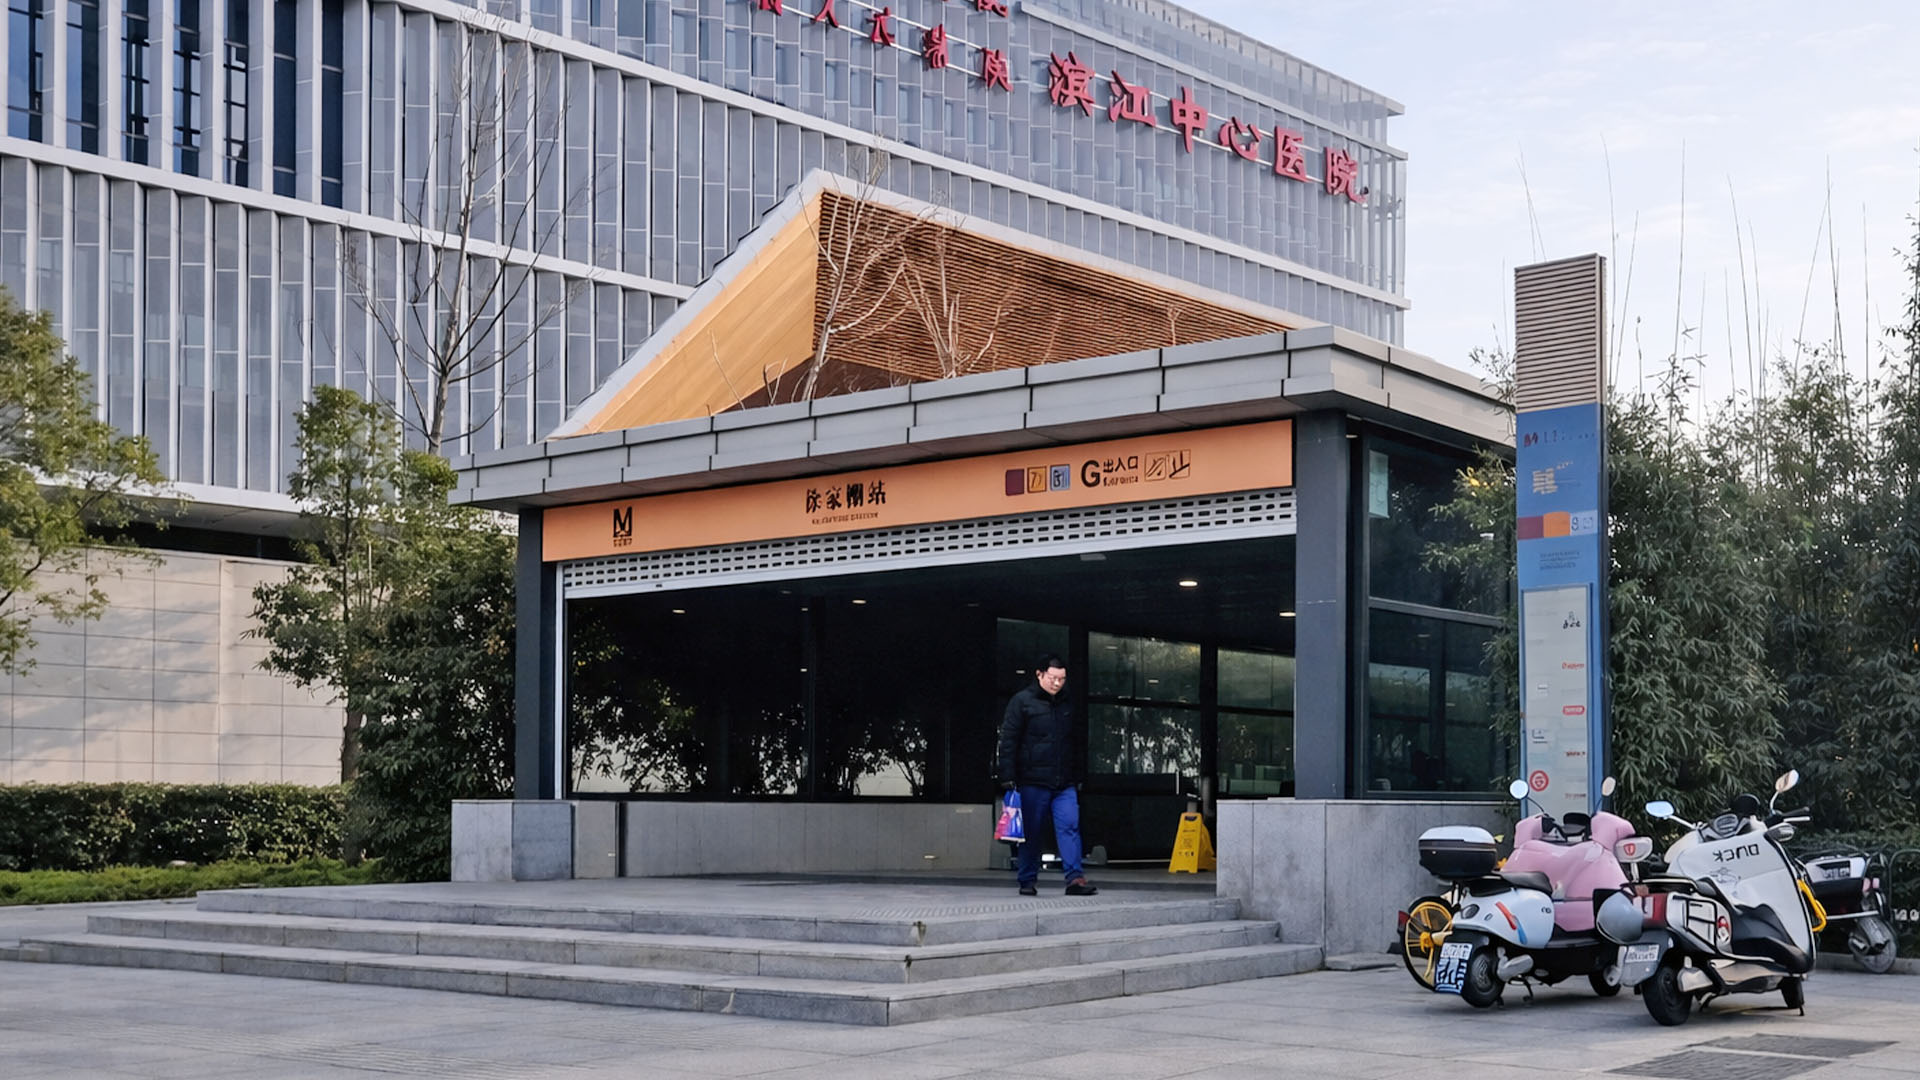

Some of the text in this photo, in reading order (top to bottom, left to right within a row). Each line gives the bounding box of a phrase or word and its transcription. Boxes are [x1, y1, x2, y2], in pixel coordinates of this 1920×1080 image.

[1049, 51, 1368, 204] 滨江中心医院
[1081, 460, 1100, 488] G
[1103, 456, 1138, 473] 出入口
[1712, 844, 1760, 862] DUCK
